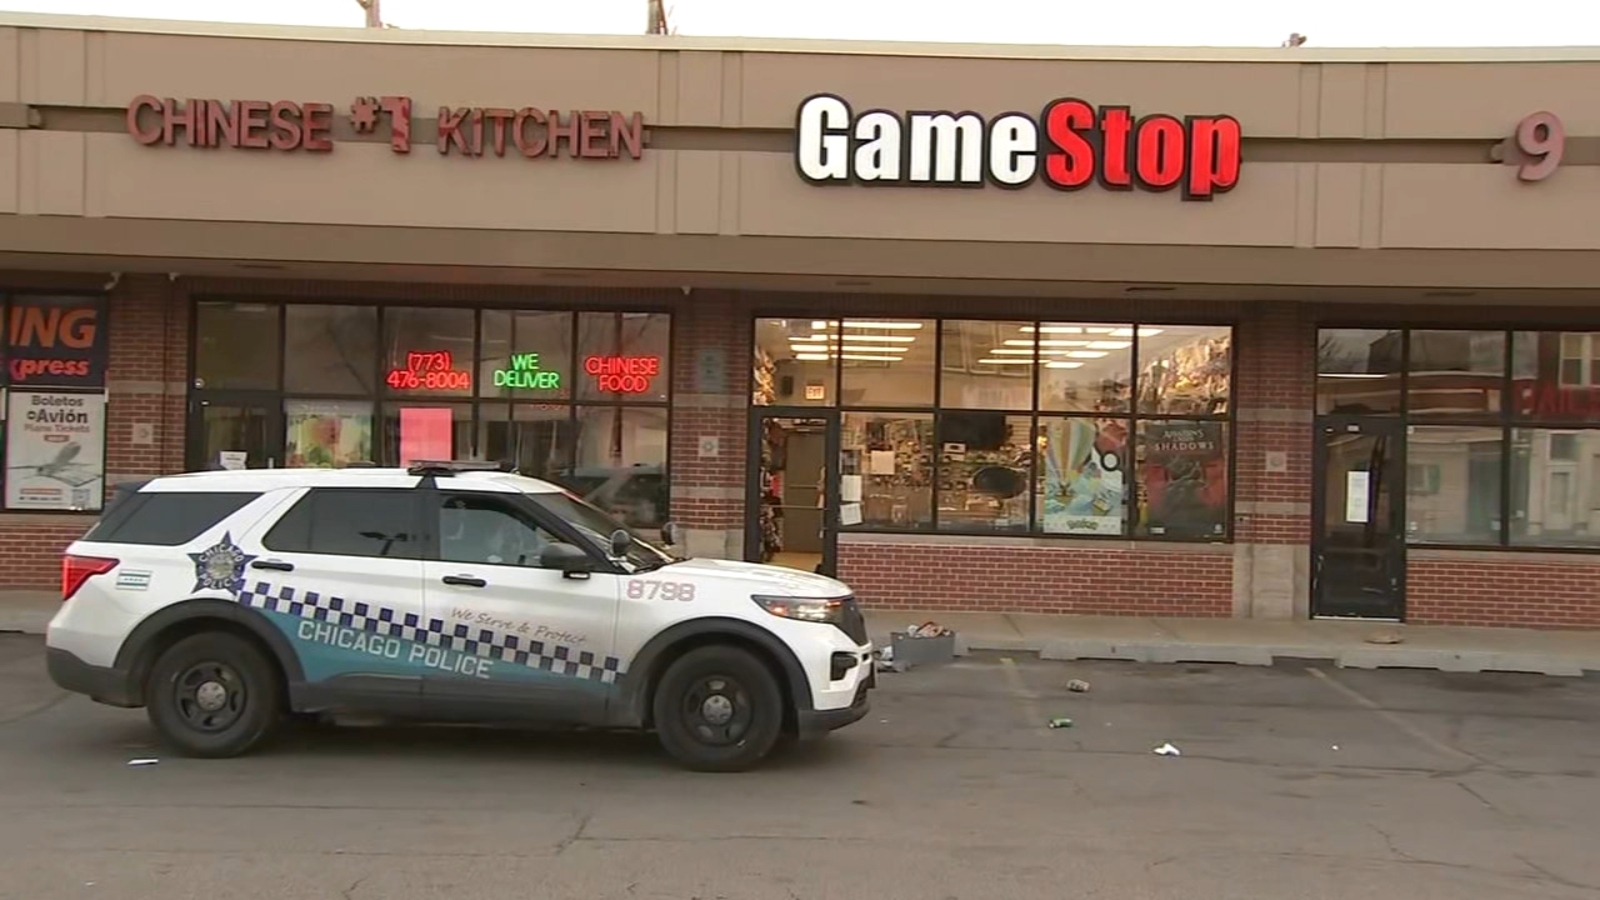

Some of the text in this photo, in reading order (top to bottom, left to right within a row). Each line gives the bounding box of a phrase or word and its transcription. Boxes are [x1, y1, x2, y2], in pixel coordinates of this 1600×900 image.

[127, 95, 643, 159] CHINESE #1 KITCHEN
[796, 94, 1241, 200] GameStop
[1516, 111, 1564, 182] 9
[407, 351, 451, 371] (773)
[511, 353, 540, 370] WE
[585, 357, 658, 374] CHINESE
[386, 370, 470, 389] 476-8004
[494, 369, 560, 389] DELIVER
[599, 374, 647, 392] FOOD
[31, 395, 84, 406] Boletos
[1154, 442, 1214, 450] SHADOWS
[627, 579, 696, 601] 8798
[451, 607, 588, 643] We Serve & Protect
[298, 620, 494, 679] CHICAGO POLICE
